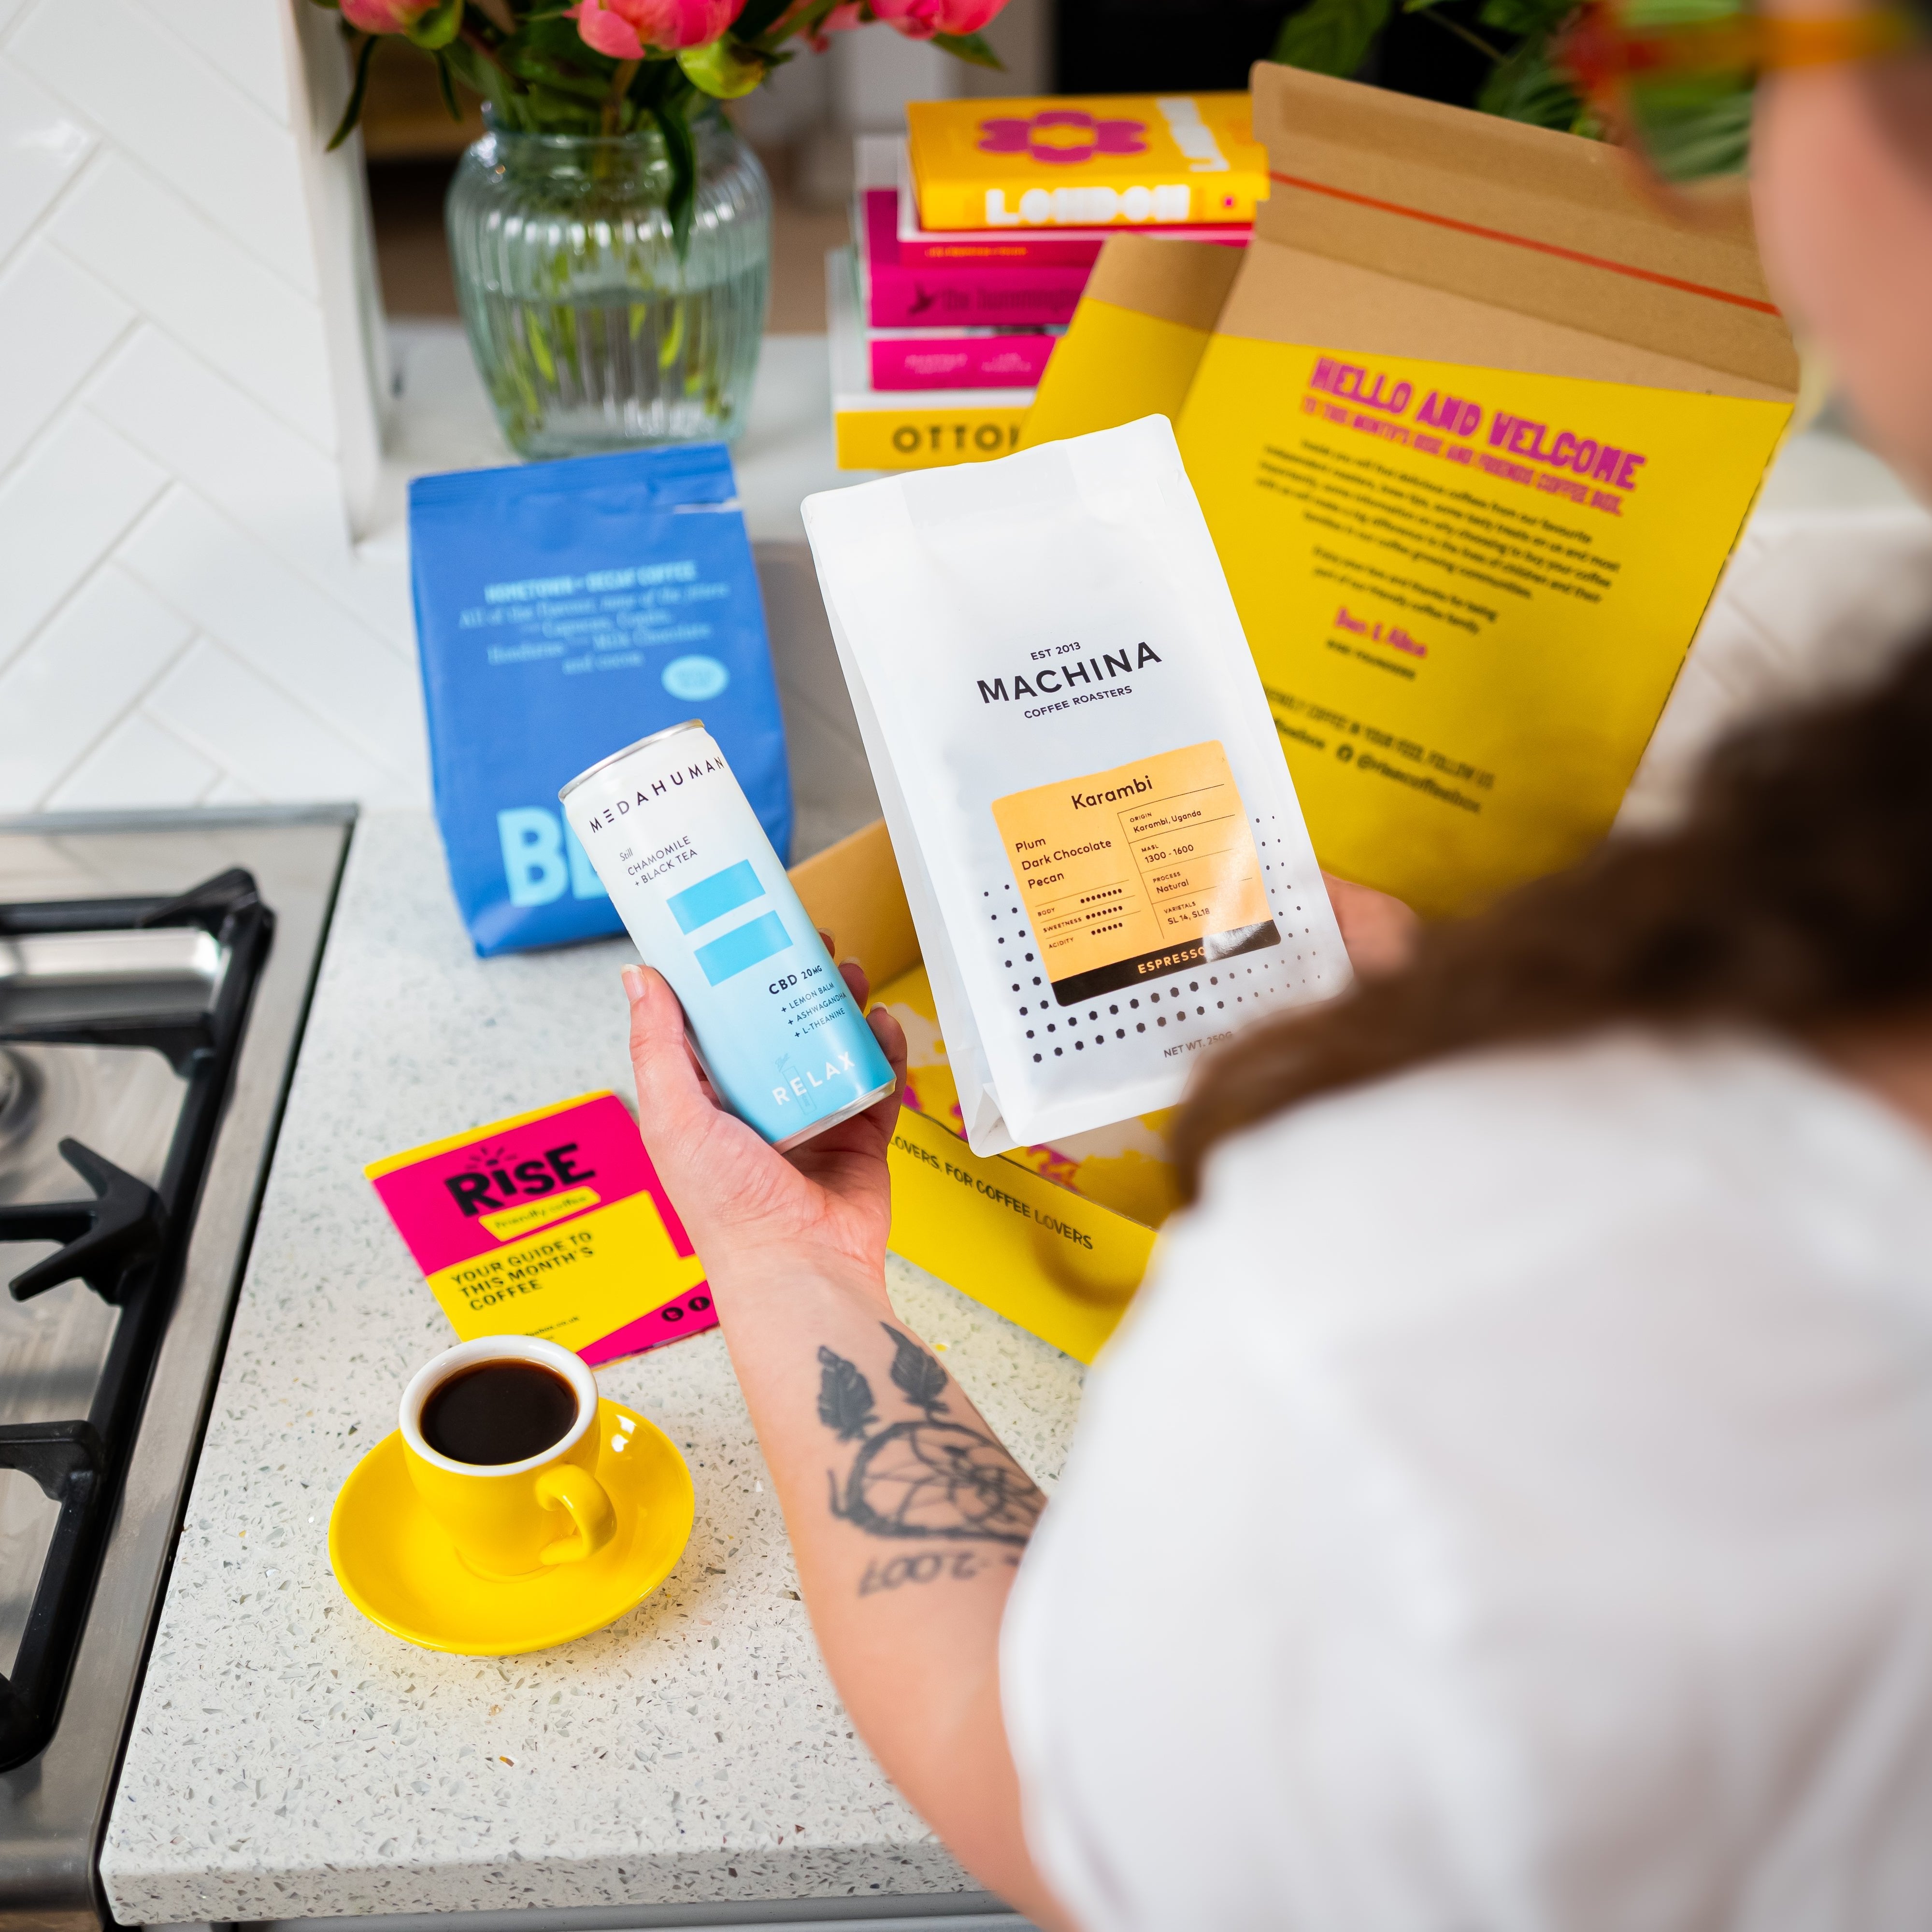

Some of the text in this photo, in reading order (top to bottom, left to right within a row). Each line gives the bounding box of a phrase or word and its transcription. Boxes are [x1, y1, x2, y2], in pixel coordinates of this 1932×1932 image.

[1309, 356, 1646, 490] HELLO AND WELCOME
[1030, 641, 1081, 661] EST 2013
[977, 641, 1162, 704] MACHINA
[1024, 685, 1132, 719] COFFEE ROASTERS
[1072, 775, 1153, 810] Karambi
[1130, 812, 1152, 823] ORIGIN
[1133, 810, 1202, 834] Karambi, Uganda
[620, 846, 634, 862] Still
[628, 836, 692, 876] CHAMOMILE
[1016, 835, 1046, 853] Plum
[1021, 838, 1112, 870] Dark Chocolate
[1141, 844, 1159, 853] MASL
[1145, 850, 1166, 864] 1300
[1173, 844, 1194, 859] 1600
[640, 860, 675, 884] BLACK
[674, 849, 698, 869] TEA
[1028, 870, 1064, 890] Pecan
[1153, 871, 1181, 883] PROCESS
[1157, 878, 1189, 895] Natural
[1038, 907, 1055, 917] BODY
[1164, 901, 1196, 914] VARIETALS
[1192, 908, 1210, 918] SL18
[1043, 917, 1082, 933] SWEETNESS
[1048, 937, 1074, 949] ACIDITY
[1138, 946, 1205, 974] ESPRESSO
[769, 965, 822, 995] CBD 20MG
[789, 991, 817, 1010] LEMON
[818, 982, 835, 996] BALM
[796, 992, 847, 1023] ASHWAGANDHA
[802, 1008, 846, 1036] L-THEANINE
[1164, 1044, 1183, 1058] NET
[772, 1051, 856, 1106] RELAX
[945, 1163, 973, 1188] FOR
[976, 1180, 1030, 1219] COFFEE
[1034, 1209, 1093, 1250] LOVERS
[451, 1231, 593, 1286] YOUR GUIDE TO
[459, 1246, 594, 1299] THIS MONTH'S
[470, 1279, 544, 1311] COFFEE
